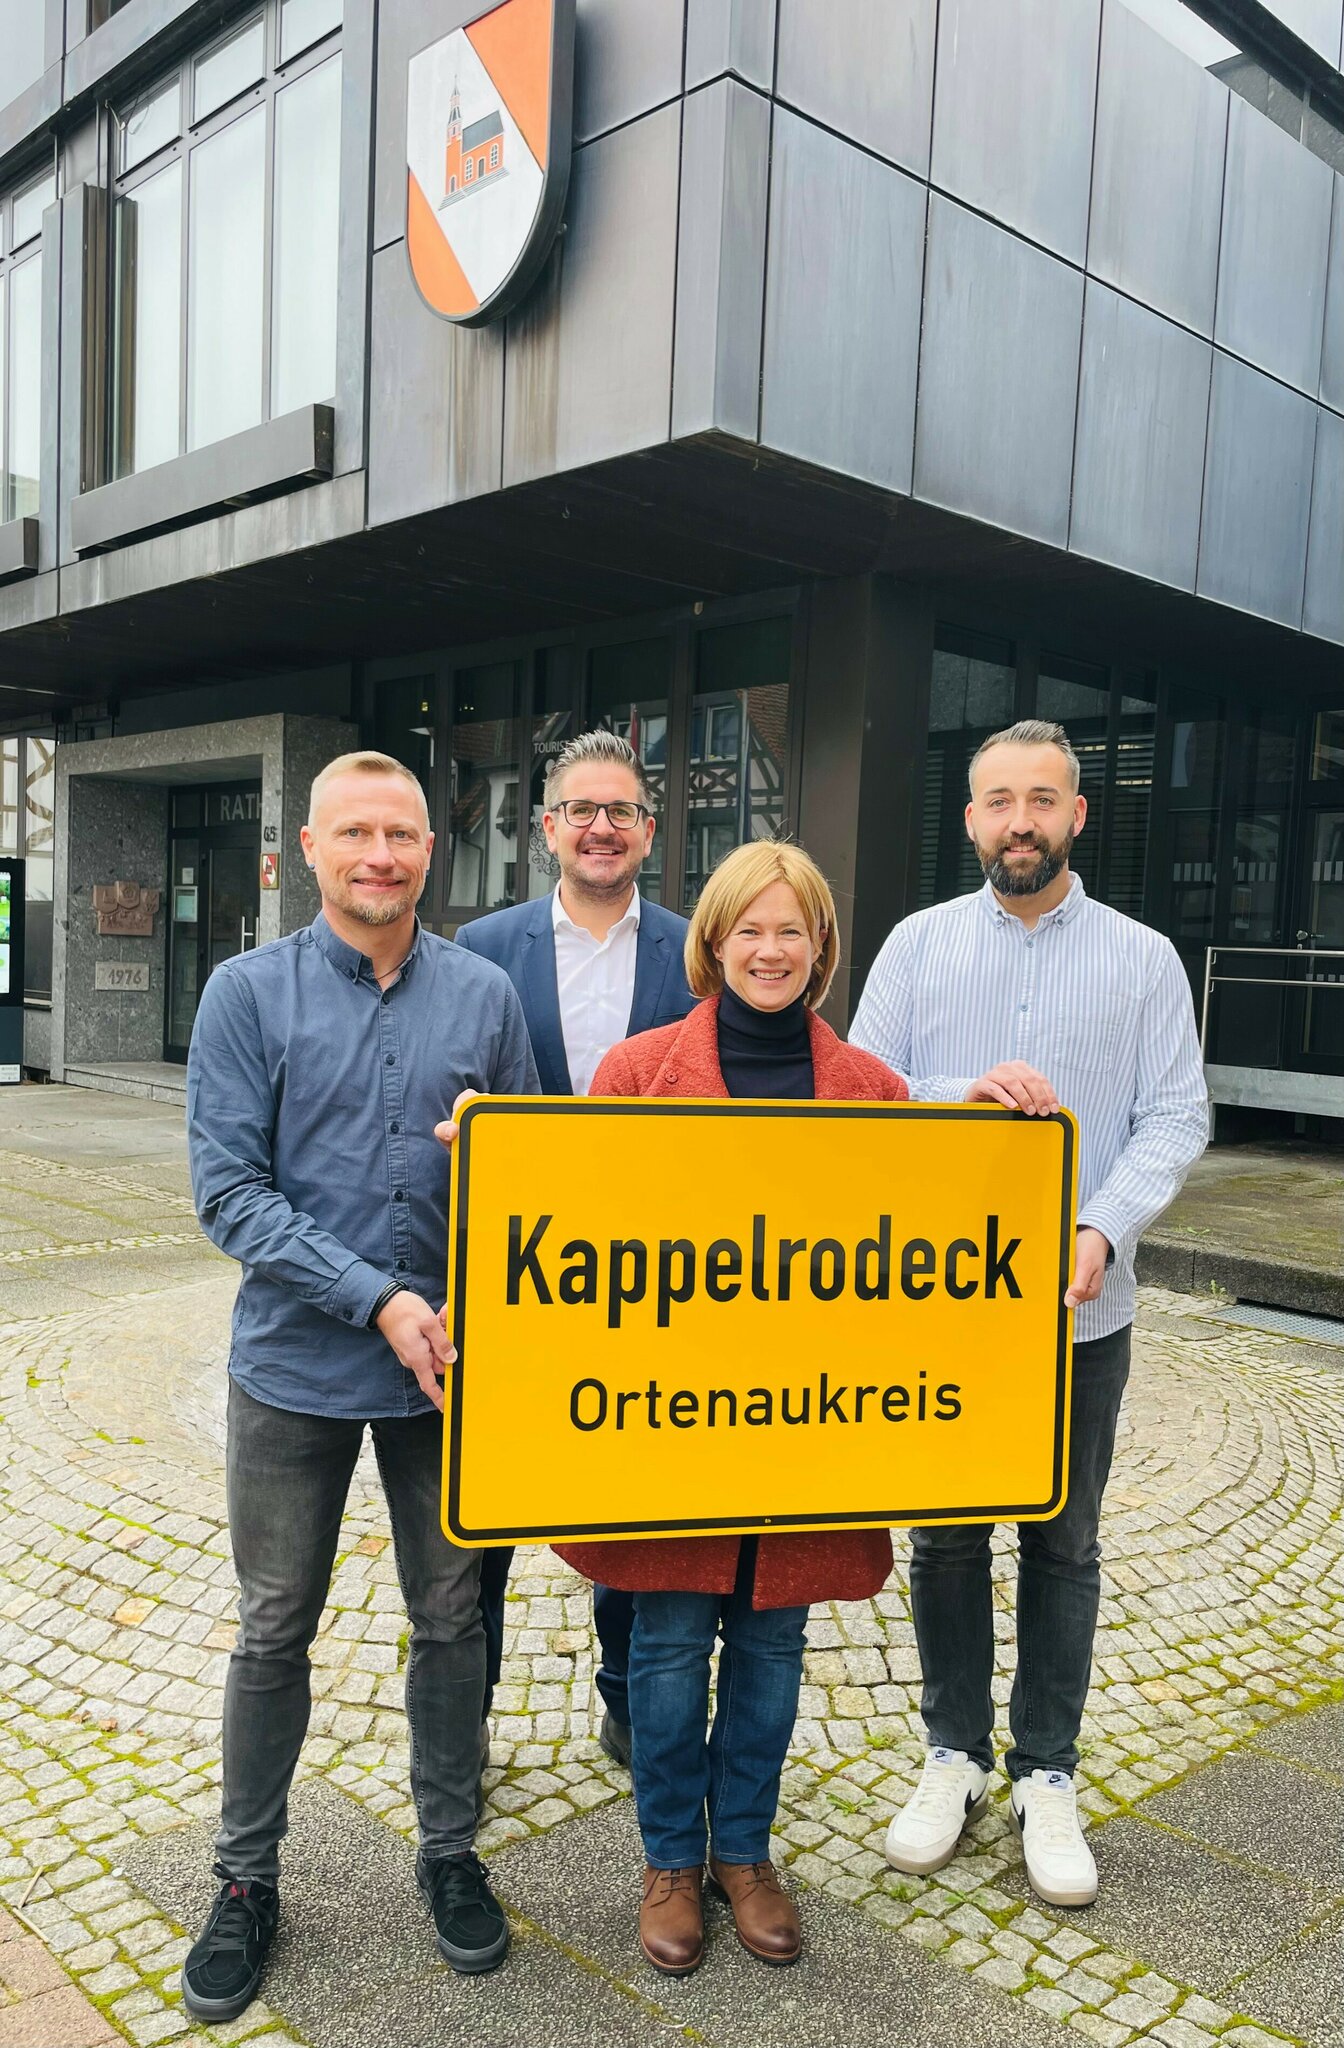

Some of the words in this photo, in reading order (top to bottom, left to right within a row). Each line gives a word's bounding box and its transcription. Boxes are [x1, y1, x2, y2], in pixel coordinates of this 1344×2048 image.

[264, 826, 277, 842] 65
[108, 969, 142, 985] 1976
[507, 1215, 1022, 1328] Kappelrodeck
[570, 1371, 961, 1431] Ortenaukreis
